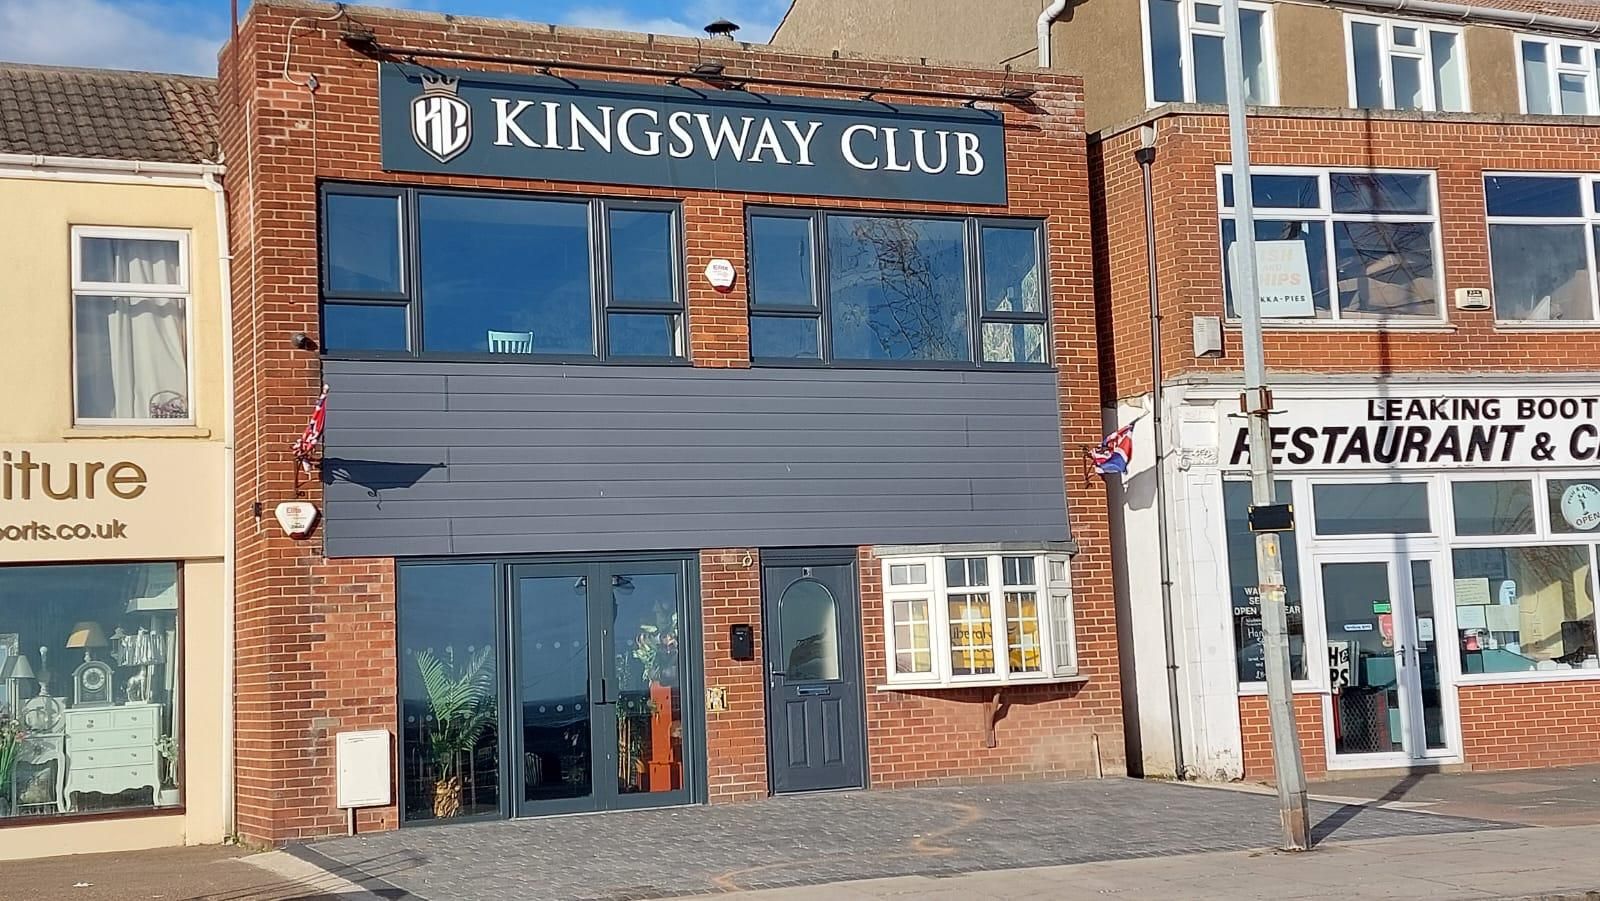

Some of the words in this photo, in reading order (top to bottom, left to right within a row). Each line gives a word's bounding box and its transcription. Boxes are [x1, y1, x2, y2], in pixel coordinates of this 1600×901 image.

[492, 97, 824, 167] KINGSWAY
[841, 124, 986, 176] CLUB
[1260, 295, 1306, 303] KKA-PIES
[1368, 398, 1501, 421] LEAKING
[1518, 398, 1599, 420] BOOT
[1531, 431, 1556, 461] &
[1569, 423, 1600, 461] C
[3, 450, 147, 500] iture
[1576, 512, 1600, 526] OPEN
[1234, 606, 1257, 616] OPEN
[1283, 605, 1300, 614] EAR
